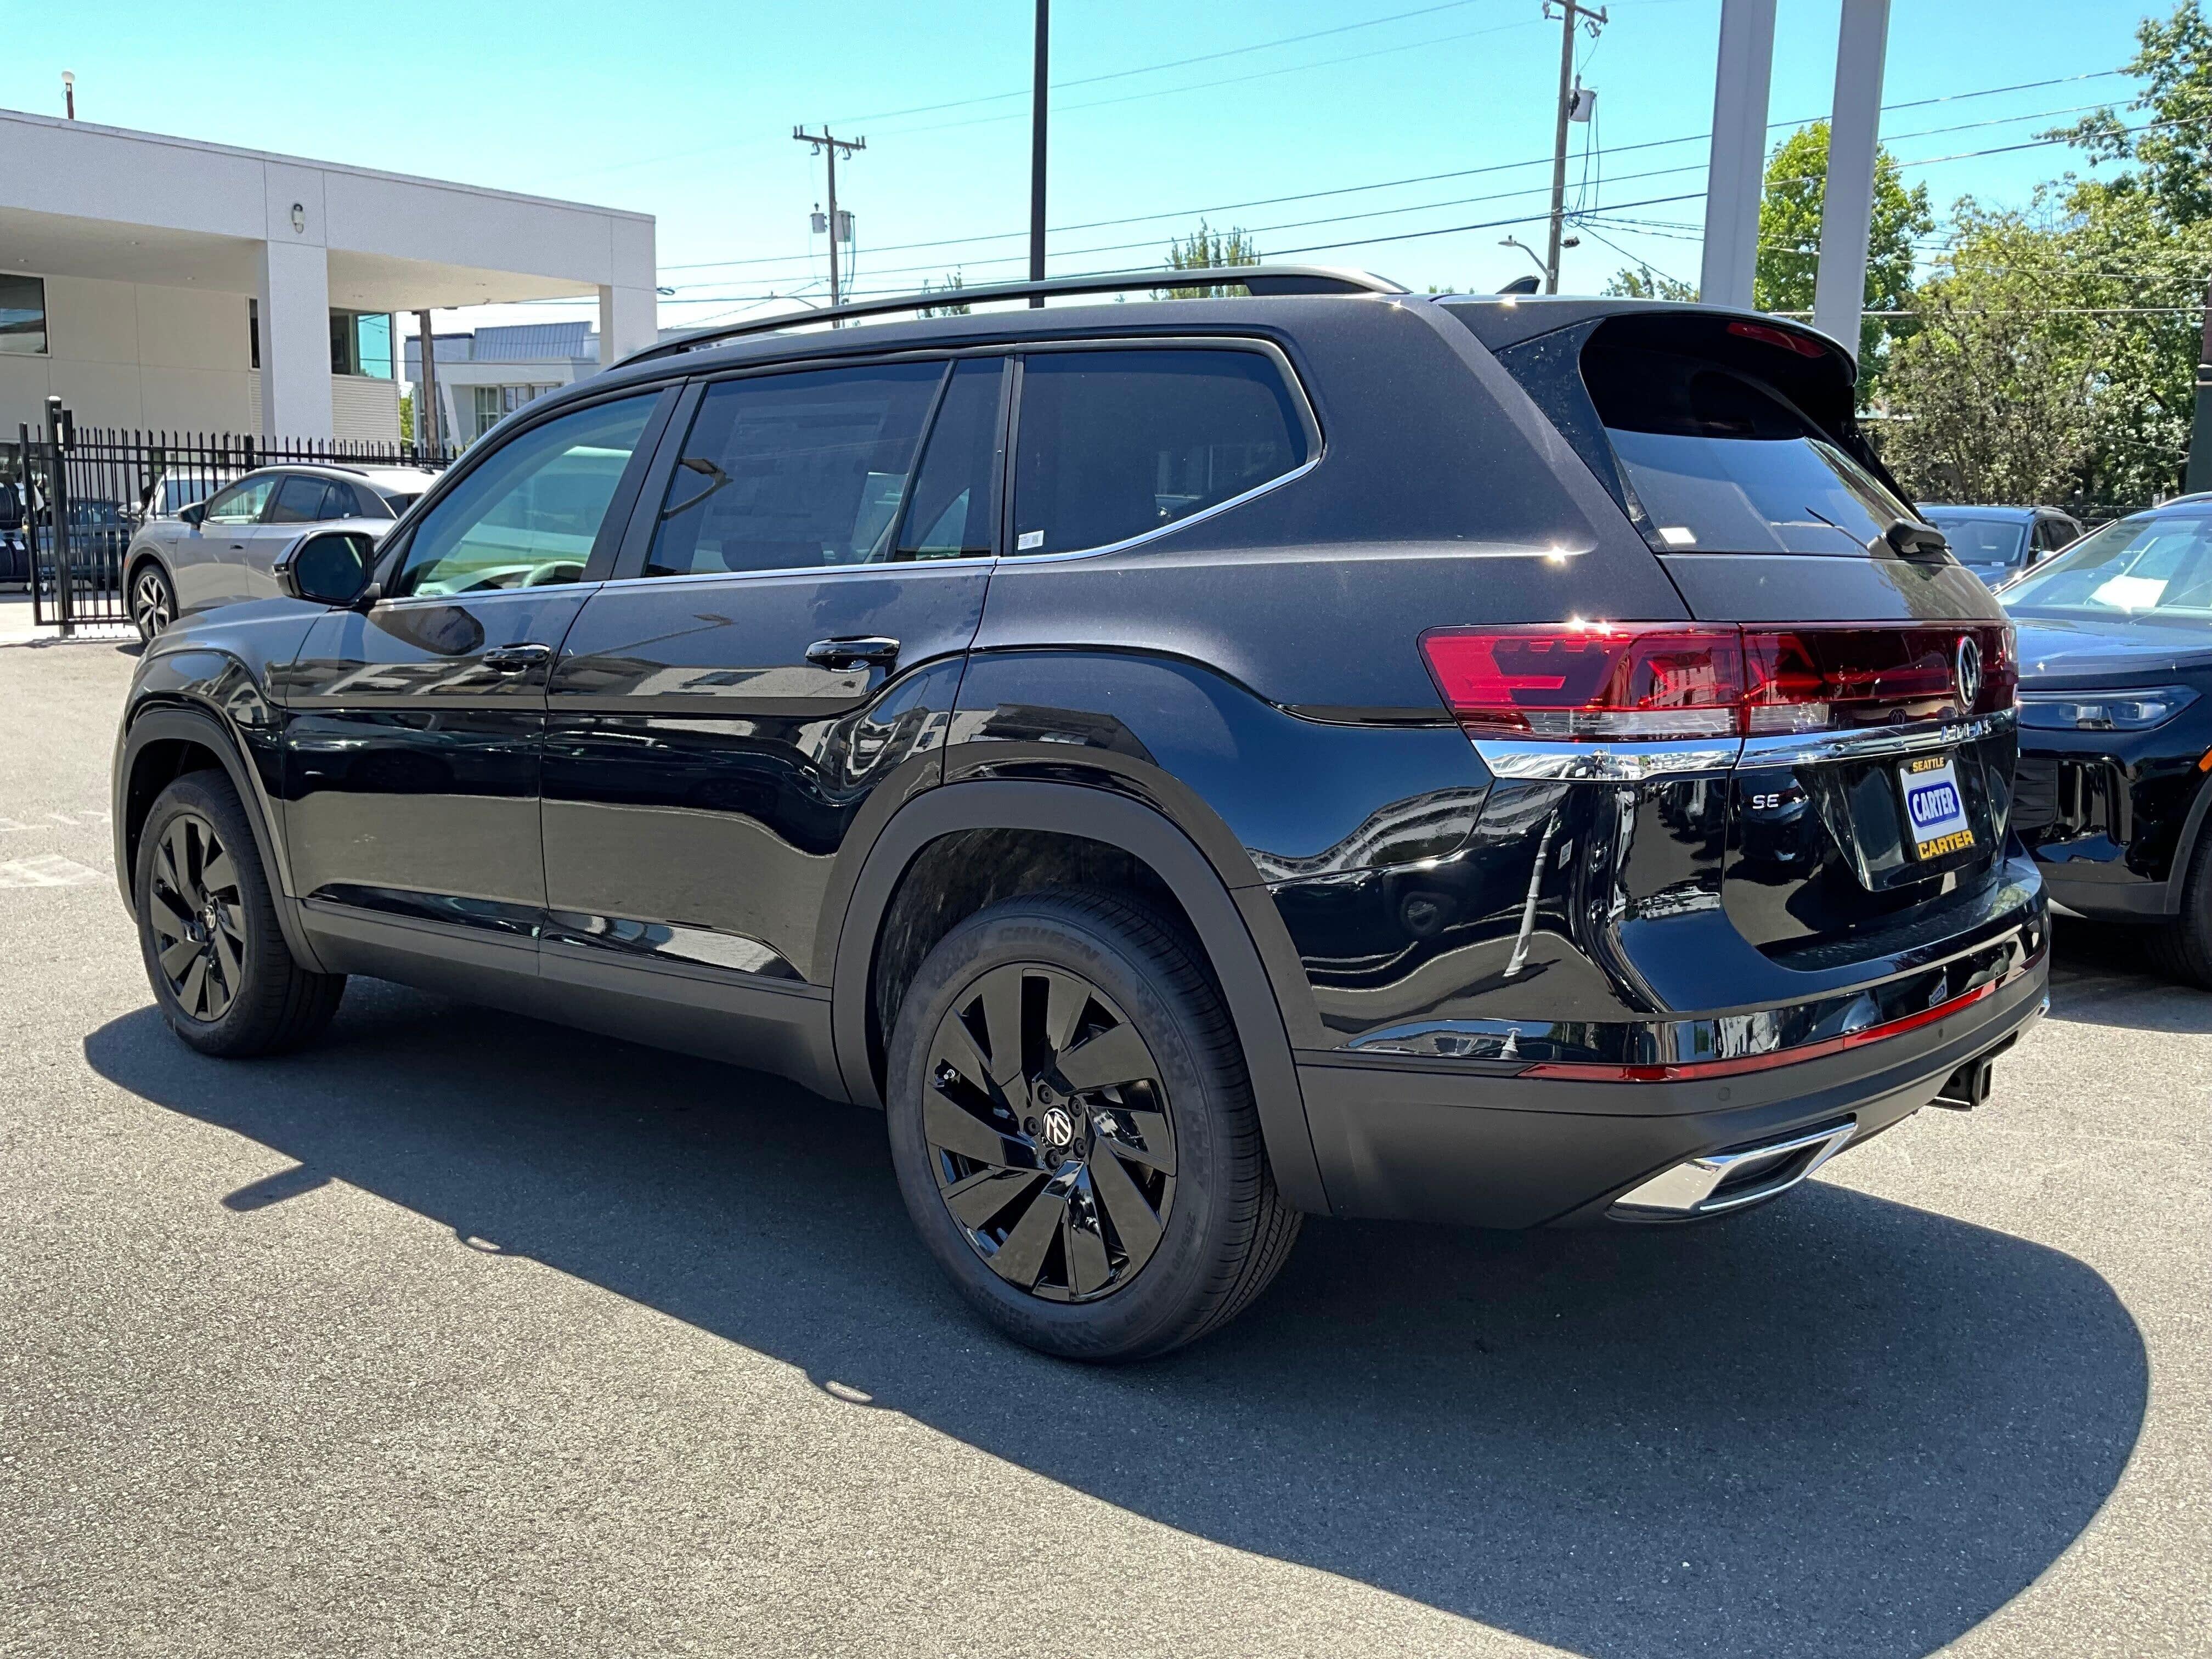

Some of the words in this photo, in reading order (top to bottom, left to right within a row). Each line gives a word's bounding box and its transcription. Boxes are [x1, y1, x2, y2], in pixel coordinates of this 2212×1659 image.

[1939, 719, 1992, 741] ATLAS
[1912, 757, 1945, 772] SEATTLE
[1752, 793, 1780, 809] SE
[1912, 787, 1956, 822] CARTER
[1918, 830, 1974, 860] CARTER
